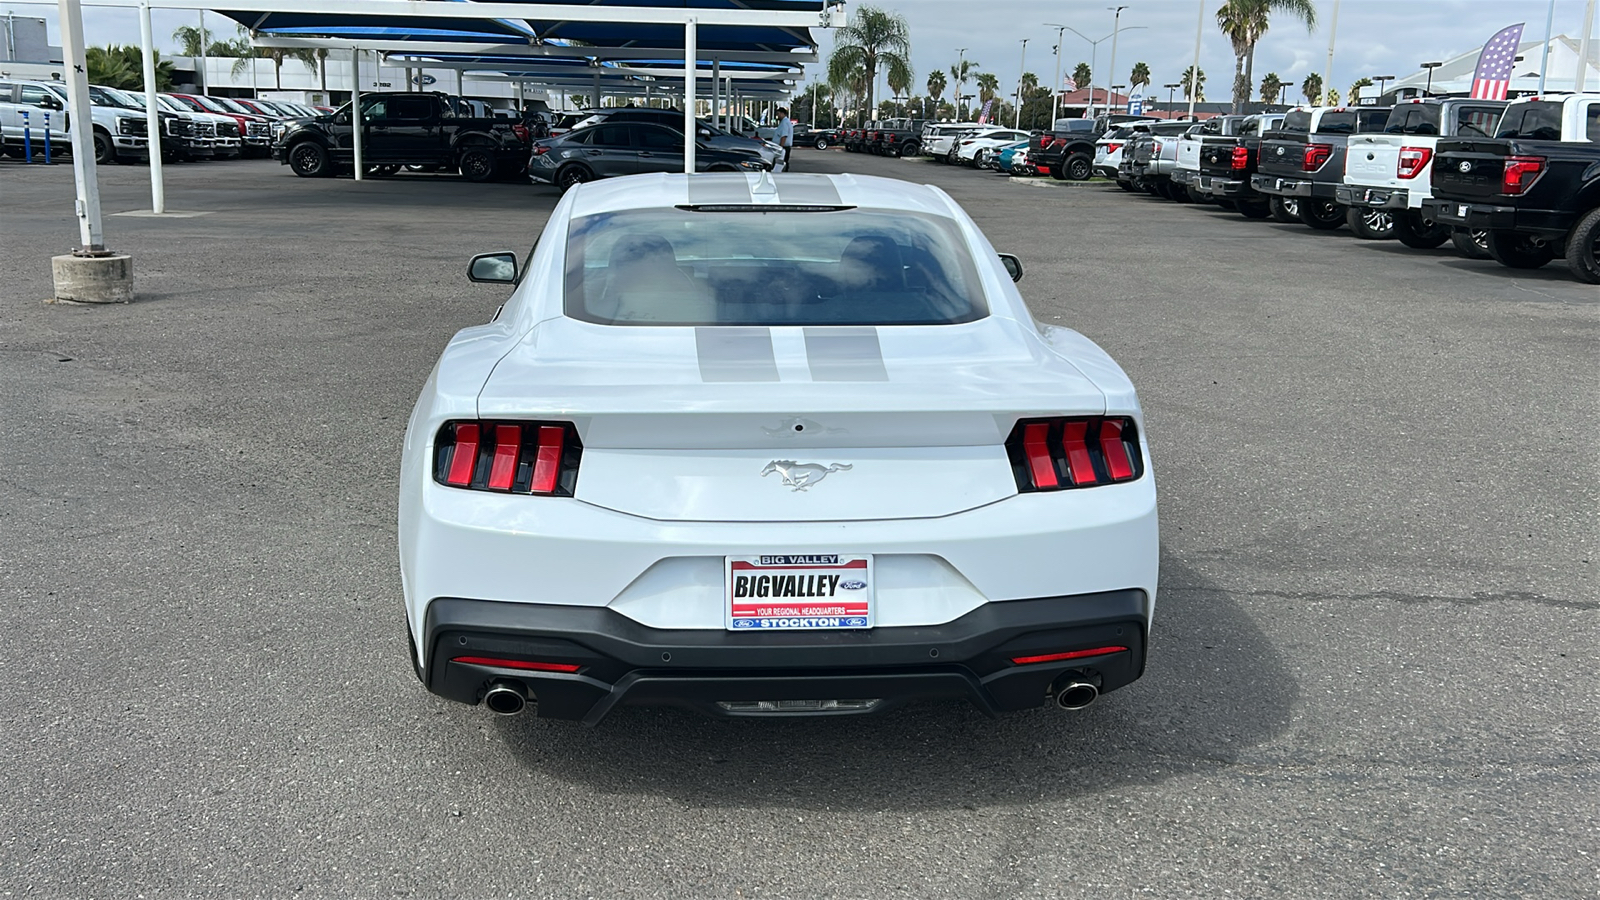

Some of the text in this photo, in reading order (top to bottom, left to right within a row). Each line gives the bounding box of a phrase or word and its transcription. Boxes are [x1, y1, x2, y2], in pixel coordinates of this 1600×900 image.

[762, 555, 837, 564] BIG VALLEY
[843, 581, 862, 589] Ford
[756, 606, 846, 616] YOUR REGIONAL HEADQUARTERS
[760, 618, 840, 628] STOCKTON
